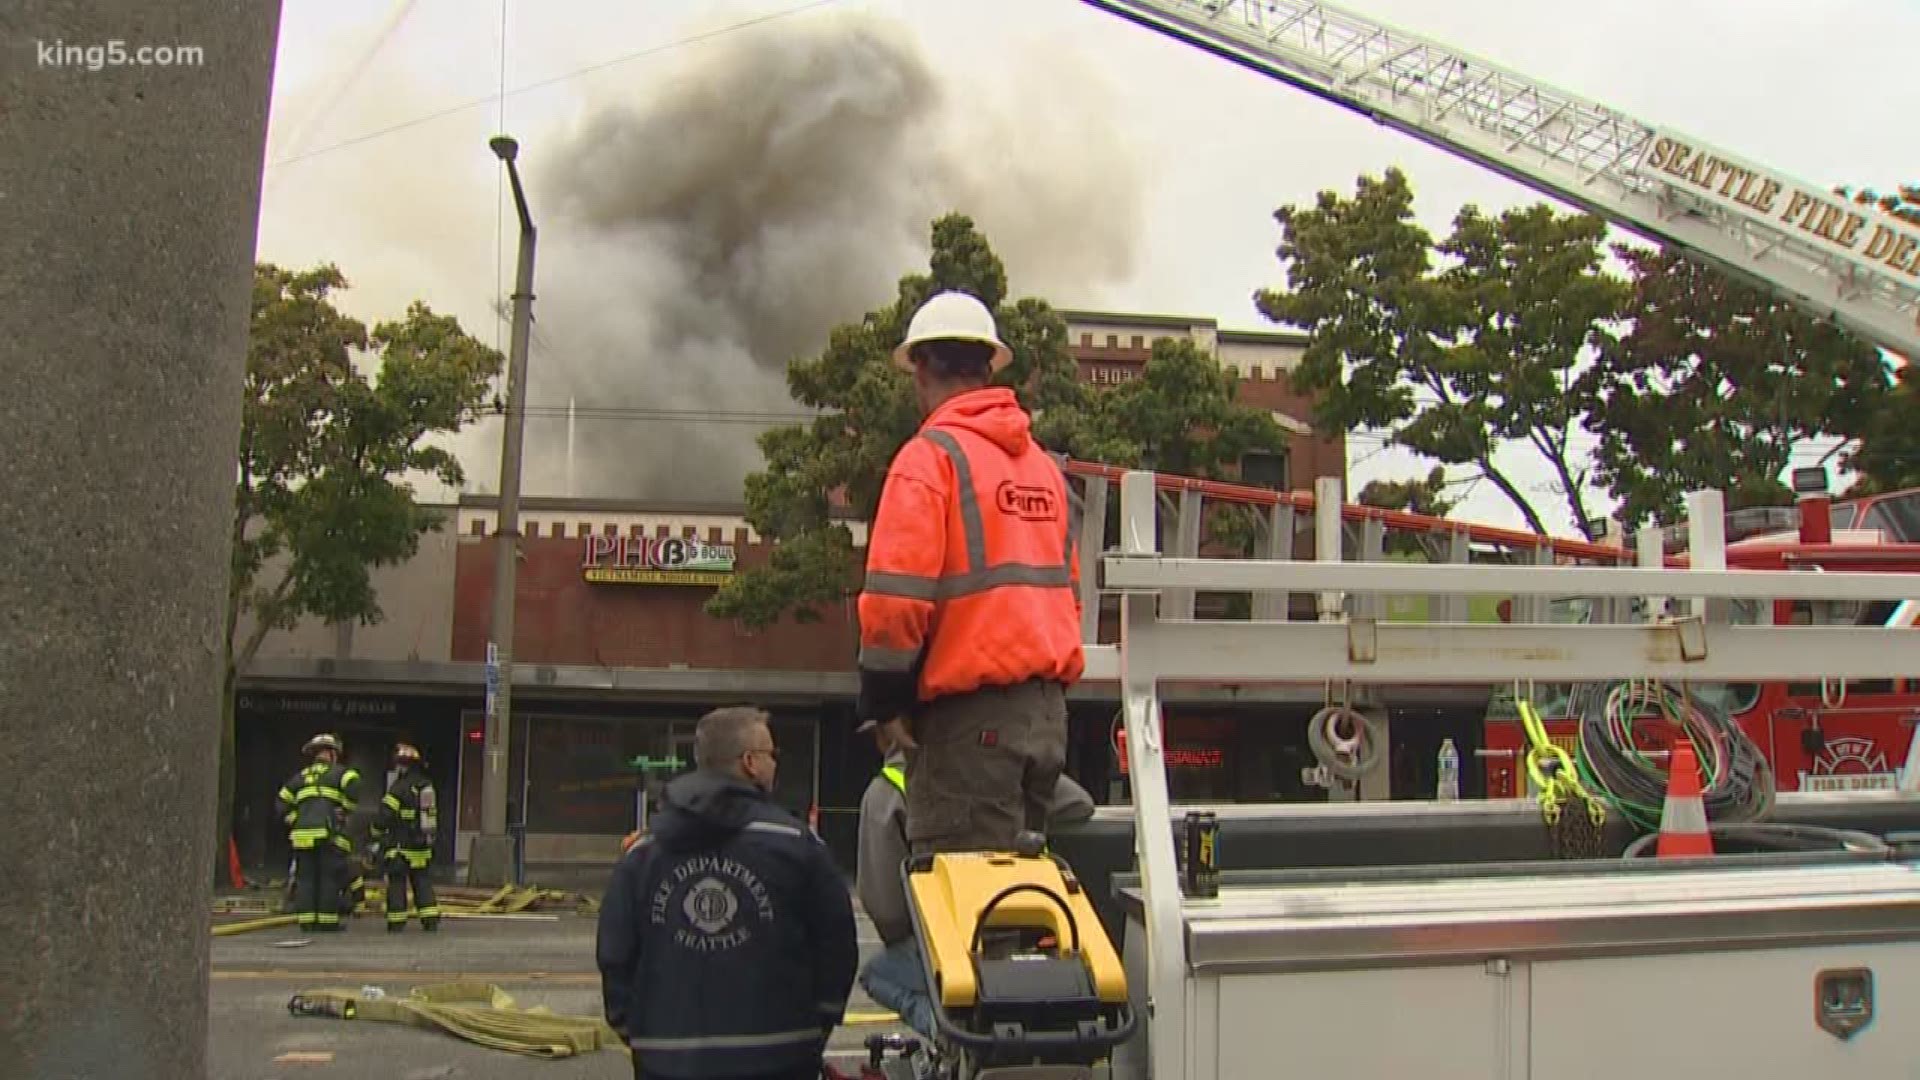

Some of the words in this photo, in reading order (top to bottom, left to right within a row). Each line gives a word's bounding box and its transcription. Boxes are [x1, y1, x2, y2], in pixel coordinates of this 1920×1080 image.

[1648, 136, 1782, 214] SEATTLE
[1780, 189, 1865, 248] FIRE
[651, 880, 672, 924] FIRE
[673, 856, 774, 921] DEPARTMENT
[674, 928, 748, 950] SEATTLE
